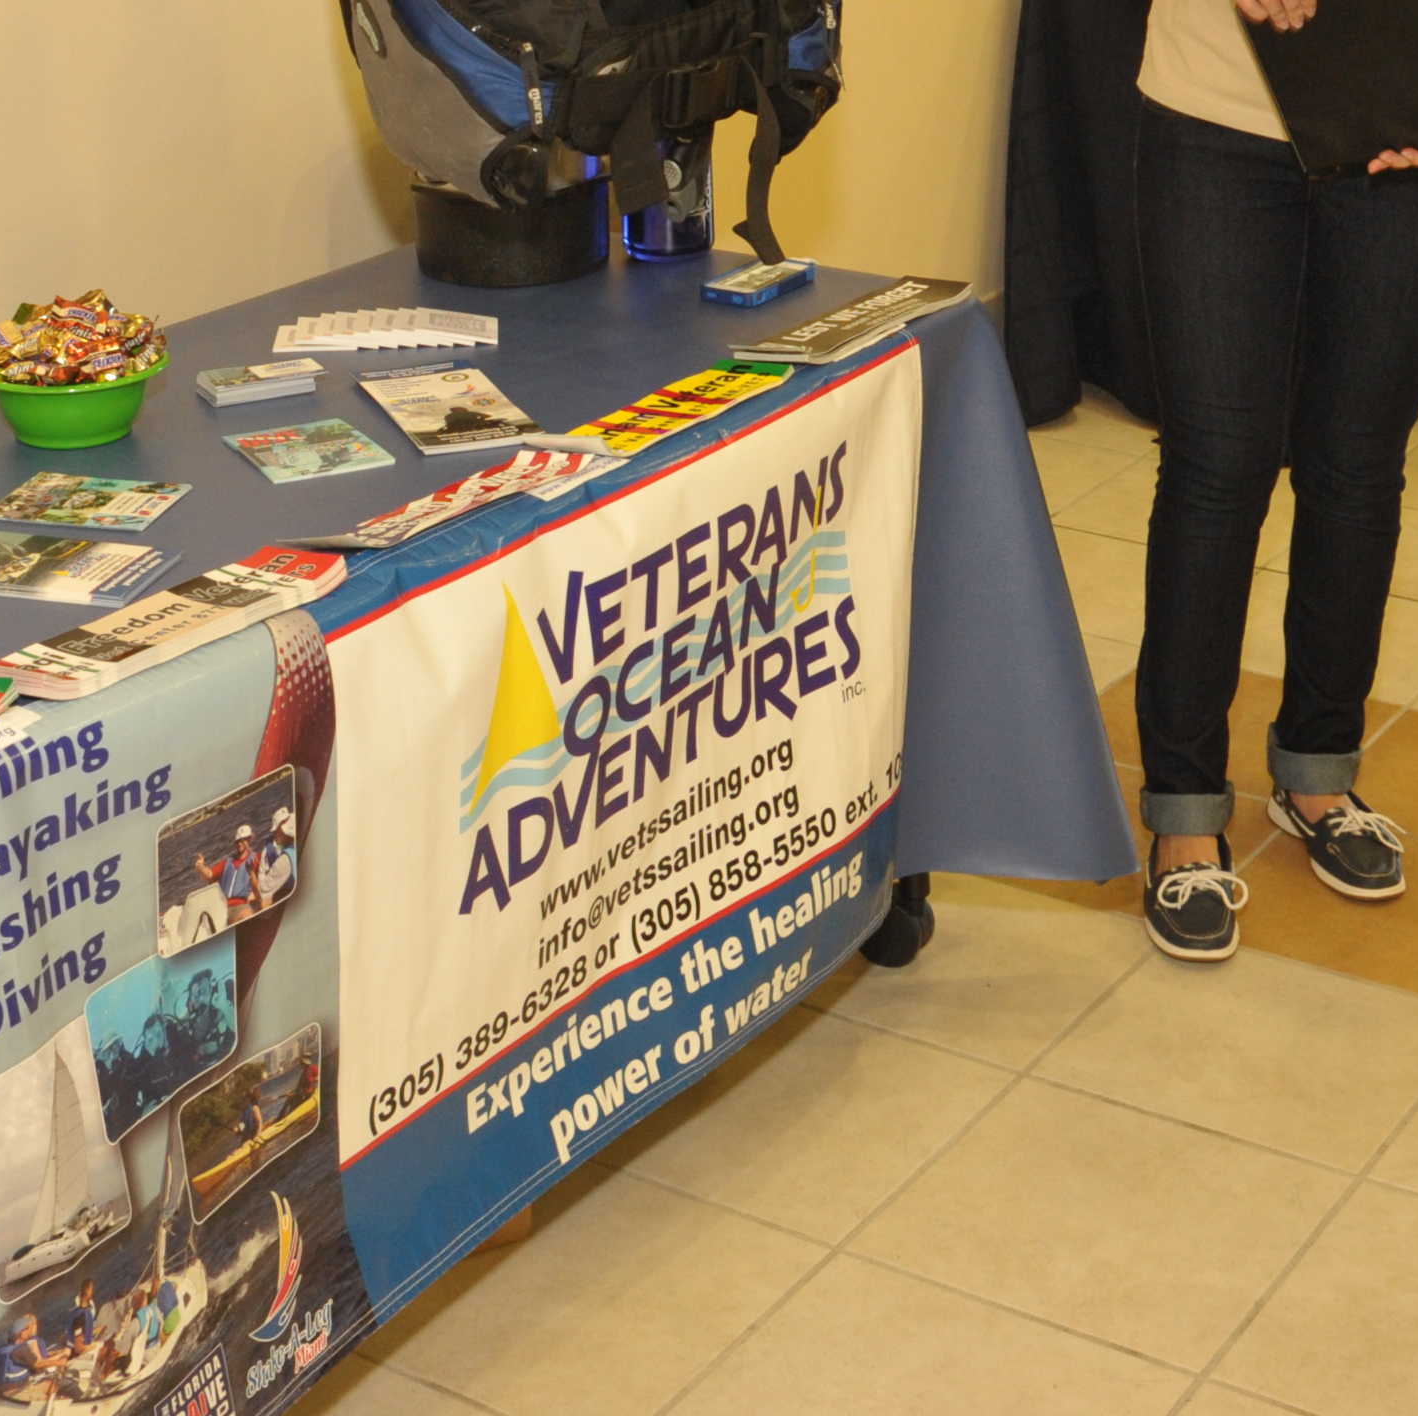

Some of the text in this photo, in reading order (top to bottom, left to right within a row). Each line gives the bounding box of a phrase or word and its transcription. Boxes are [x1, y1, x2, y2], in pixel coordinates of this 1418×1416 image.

[781, 321, 838, 342] LEST
[824, 308, 869, 322] WE
[854, 280, 929, 311] FORGET
[646, 364, 753, 409] Veteran
[57, 601, 192, 656] Freedom
[182, 553, 298, 602] Veteran
[191, 603, 227, 620] 877
[536, 440, 848, 685] VETERANS
[562, 556, 782, 766] OCEAN
[841, 679, 867, 705] inc.
[458, 595, 863, 916] ADVENTURES
[538, 734, 796, 922] www.vetssailing.org
[538, 784, 801, 971] info@vetssailing.org
[368, 1057, 446, 1137] (305)
[455, 952, 588, 1071] 389-6328
[594, 937, 621, 971] or
[630, 880, 702, 955] (305)
[709, 806, 837, 903] 858-5550
[845, 780, 878, 825] ext.
[465, 850, 865, 1134] Experience the healing
[549, 946, 816, 1166] power of water
[171, 1354, 222, 1413] FLORIDA
[246, 1298, 333, 1399] Shake-A-Leg
[294, 1327, 329, 1375] Miami
